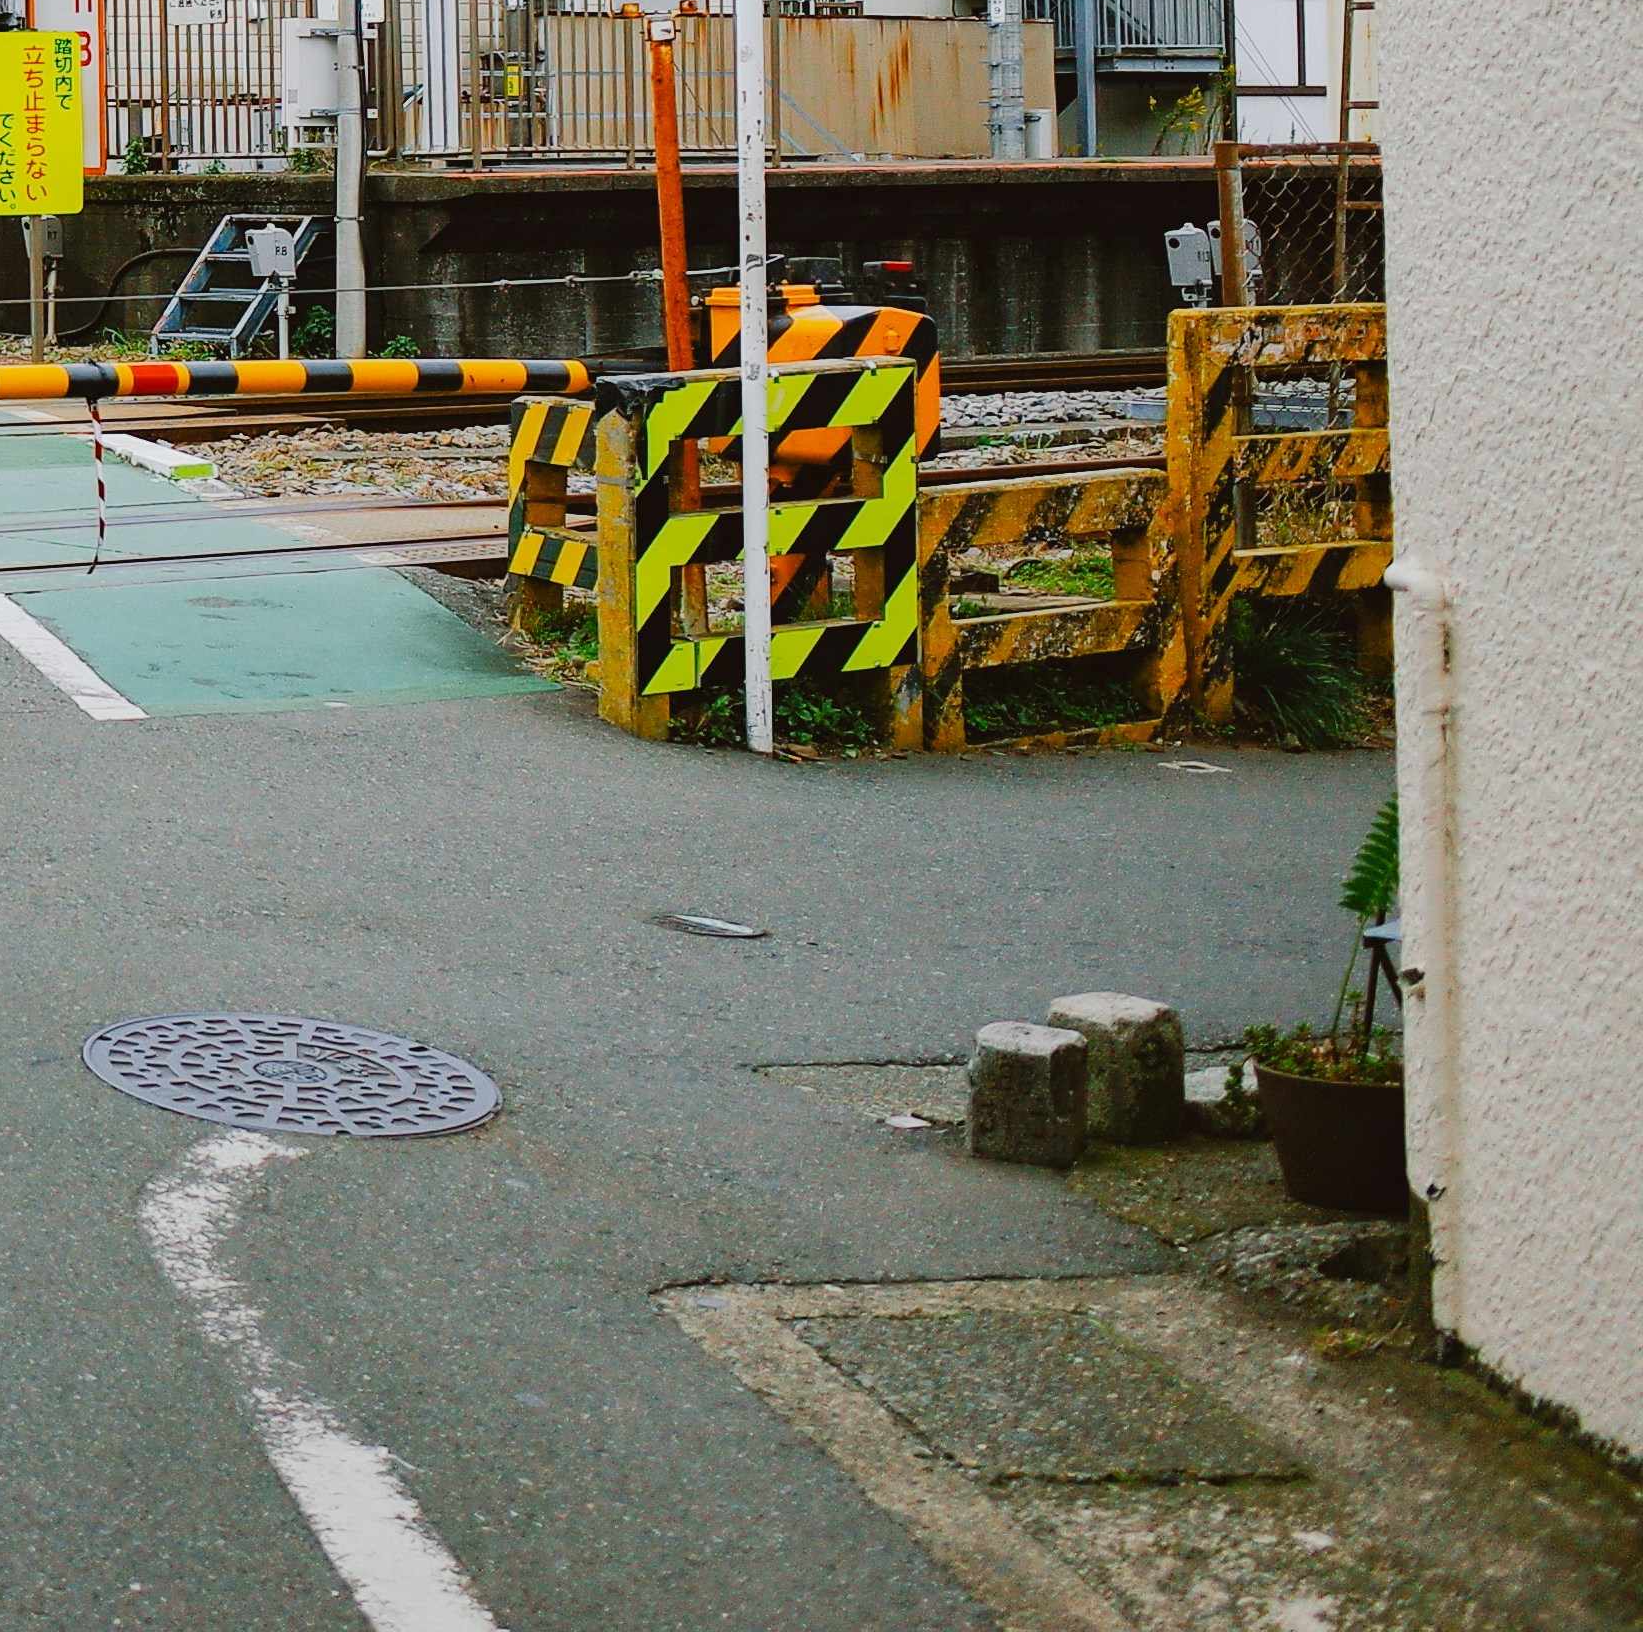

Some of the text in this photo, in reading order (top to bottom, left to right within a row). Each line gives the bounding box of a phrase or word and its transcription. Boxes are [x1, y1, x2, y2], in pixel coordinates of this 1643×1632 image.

[22, 44, 48, 202] 立ち止まらない
[54, 38, 74, 110] 踏切内で
